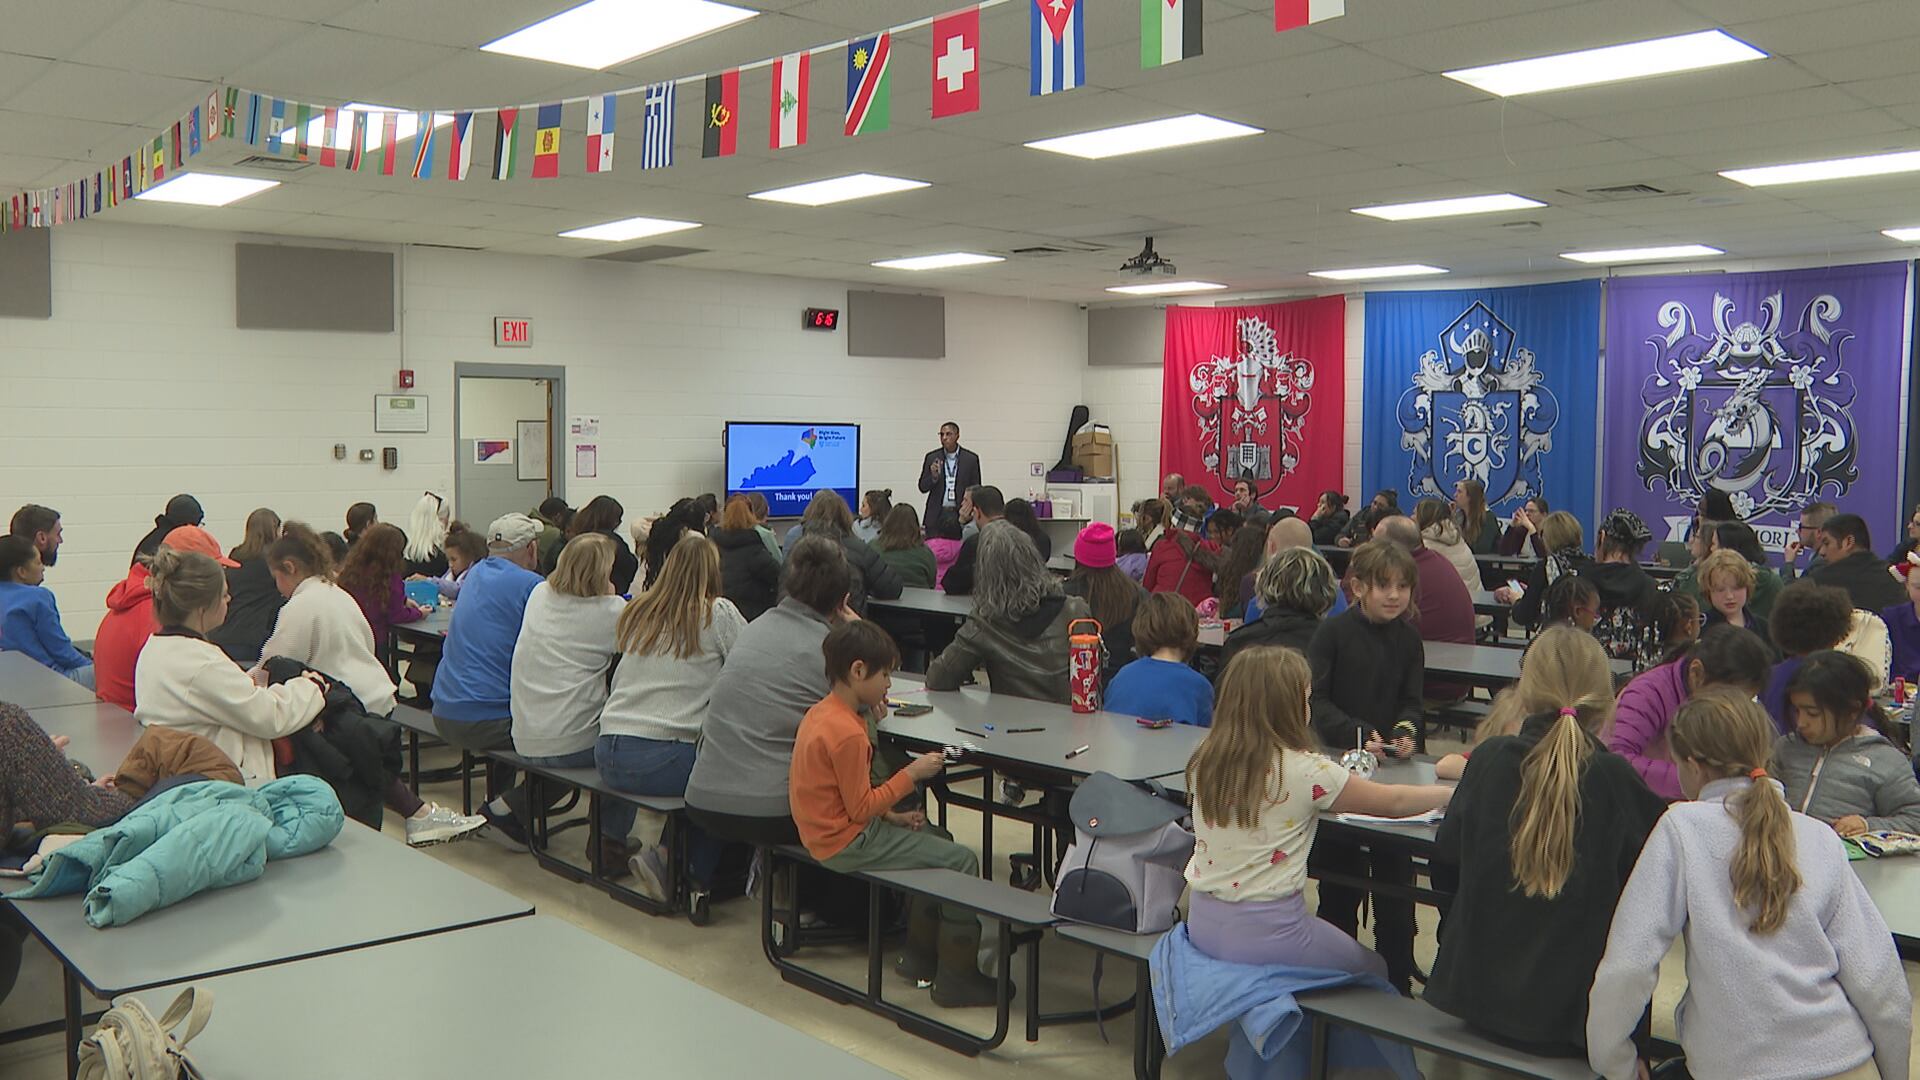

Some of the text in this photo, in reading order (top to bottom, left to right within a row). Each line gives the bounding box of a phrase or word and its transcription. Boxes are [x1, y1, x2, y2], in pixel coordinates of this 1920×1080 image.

[504, 321, 528, 341] EXIT
[775, 491, 813, 502] Thank you!
